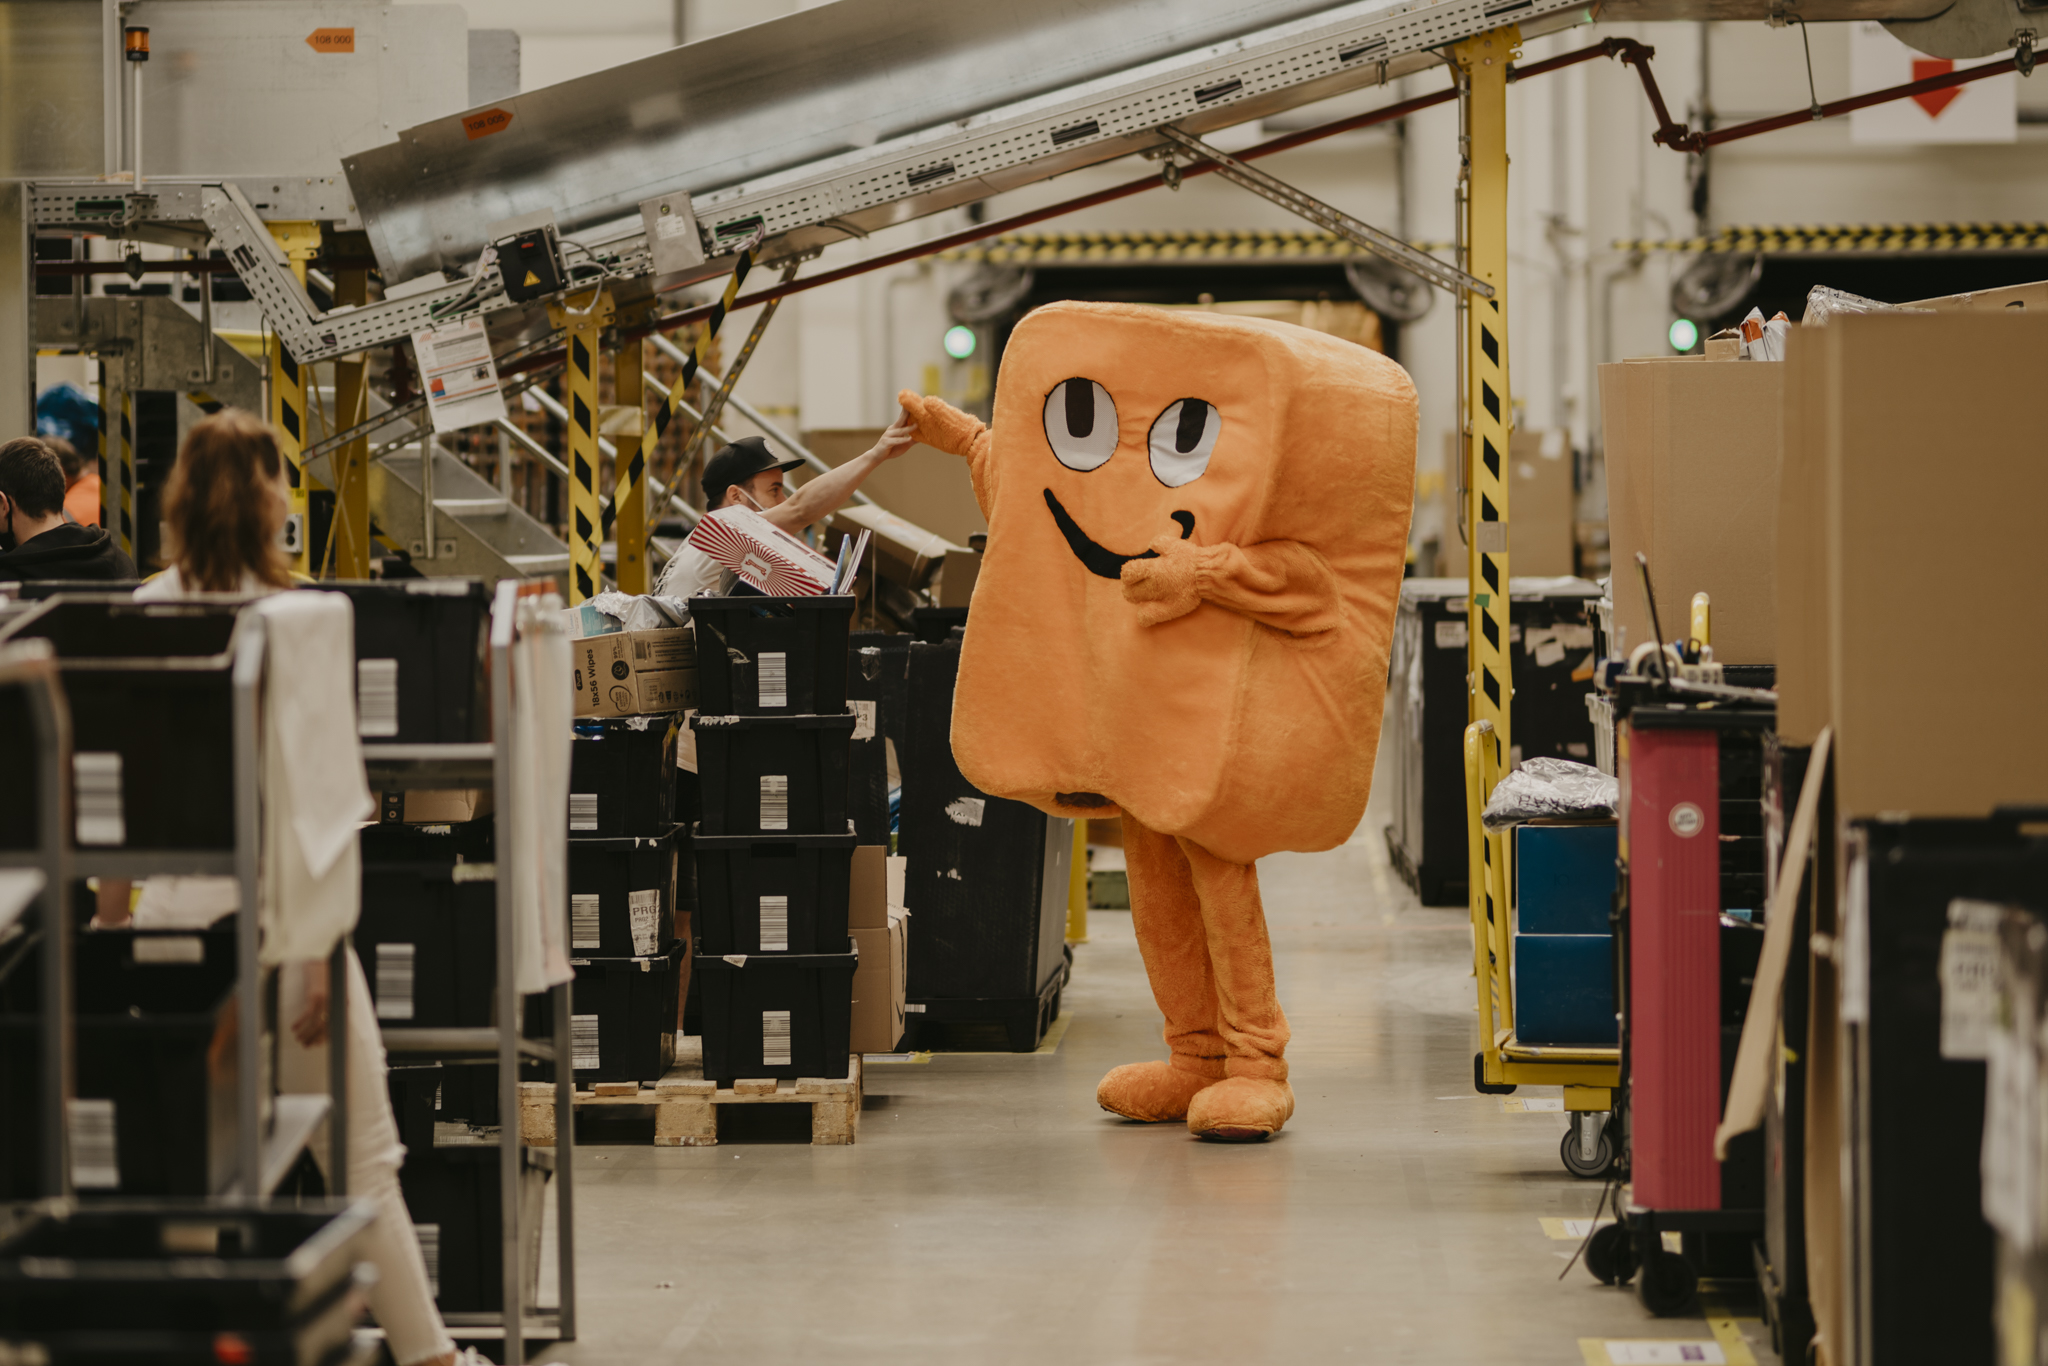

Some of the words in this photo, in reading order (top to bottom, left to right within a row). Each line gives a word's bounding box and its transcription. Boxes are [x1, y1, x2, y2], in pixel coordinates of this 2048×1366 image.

[315, 35, 331, 44] 108
[333, 35, 351, 44] 000
[468, 119, 486, 131] 108
[486, 113, 505, 126] 005
[587, 648, 596, 679] Wipes
[590, 680, 600, 707] 18x56
